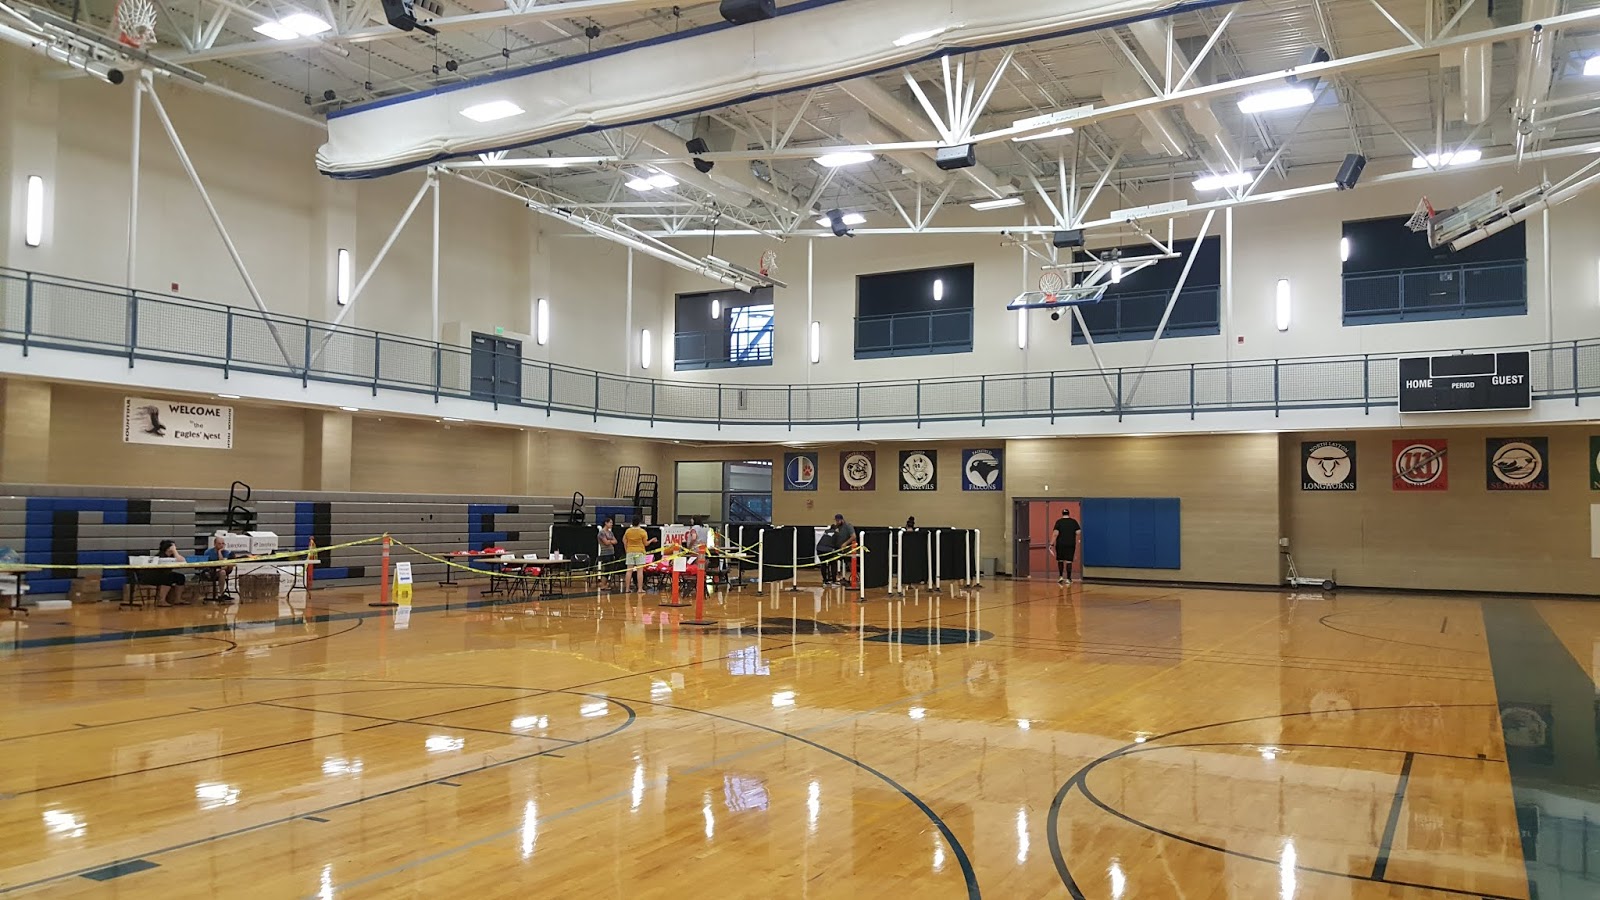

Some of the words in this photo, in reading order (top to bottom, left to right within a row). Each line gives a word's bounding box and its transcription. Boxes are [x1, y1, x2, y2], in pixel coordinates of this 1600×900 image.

[1406, 379, 1433, 389] HOME
[1492, 375, 1524, 385] GUEST
[169, 404, 221, 417] WELCOME
[193, 421, 204, 429] the
[174, 430, 202, 439] Eagles'
[203, 431, 221, 440] Nest
[1309, 442, 1328, 452] NORTH
[1328, 442, 1349, 452] LAYTON
[1303, 482, 1355, 490] LONGHORNS
[1490, 481, 1545, 489] SEAHAWKS
